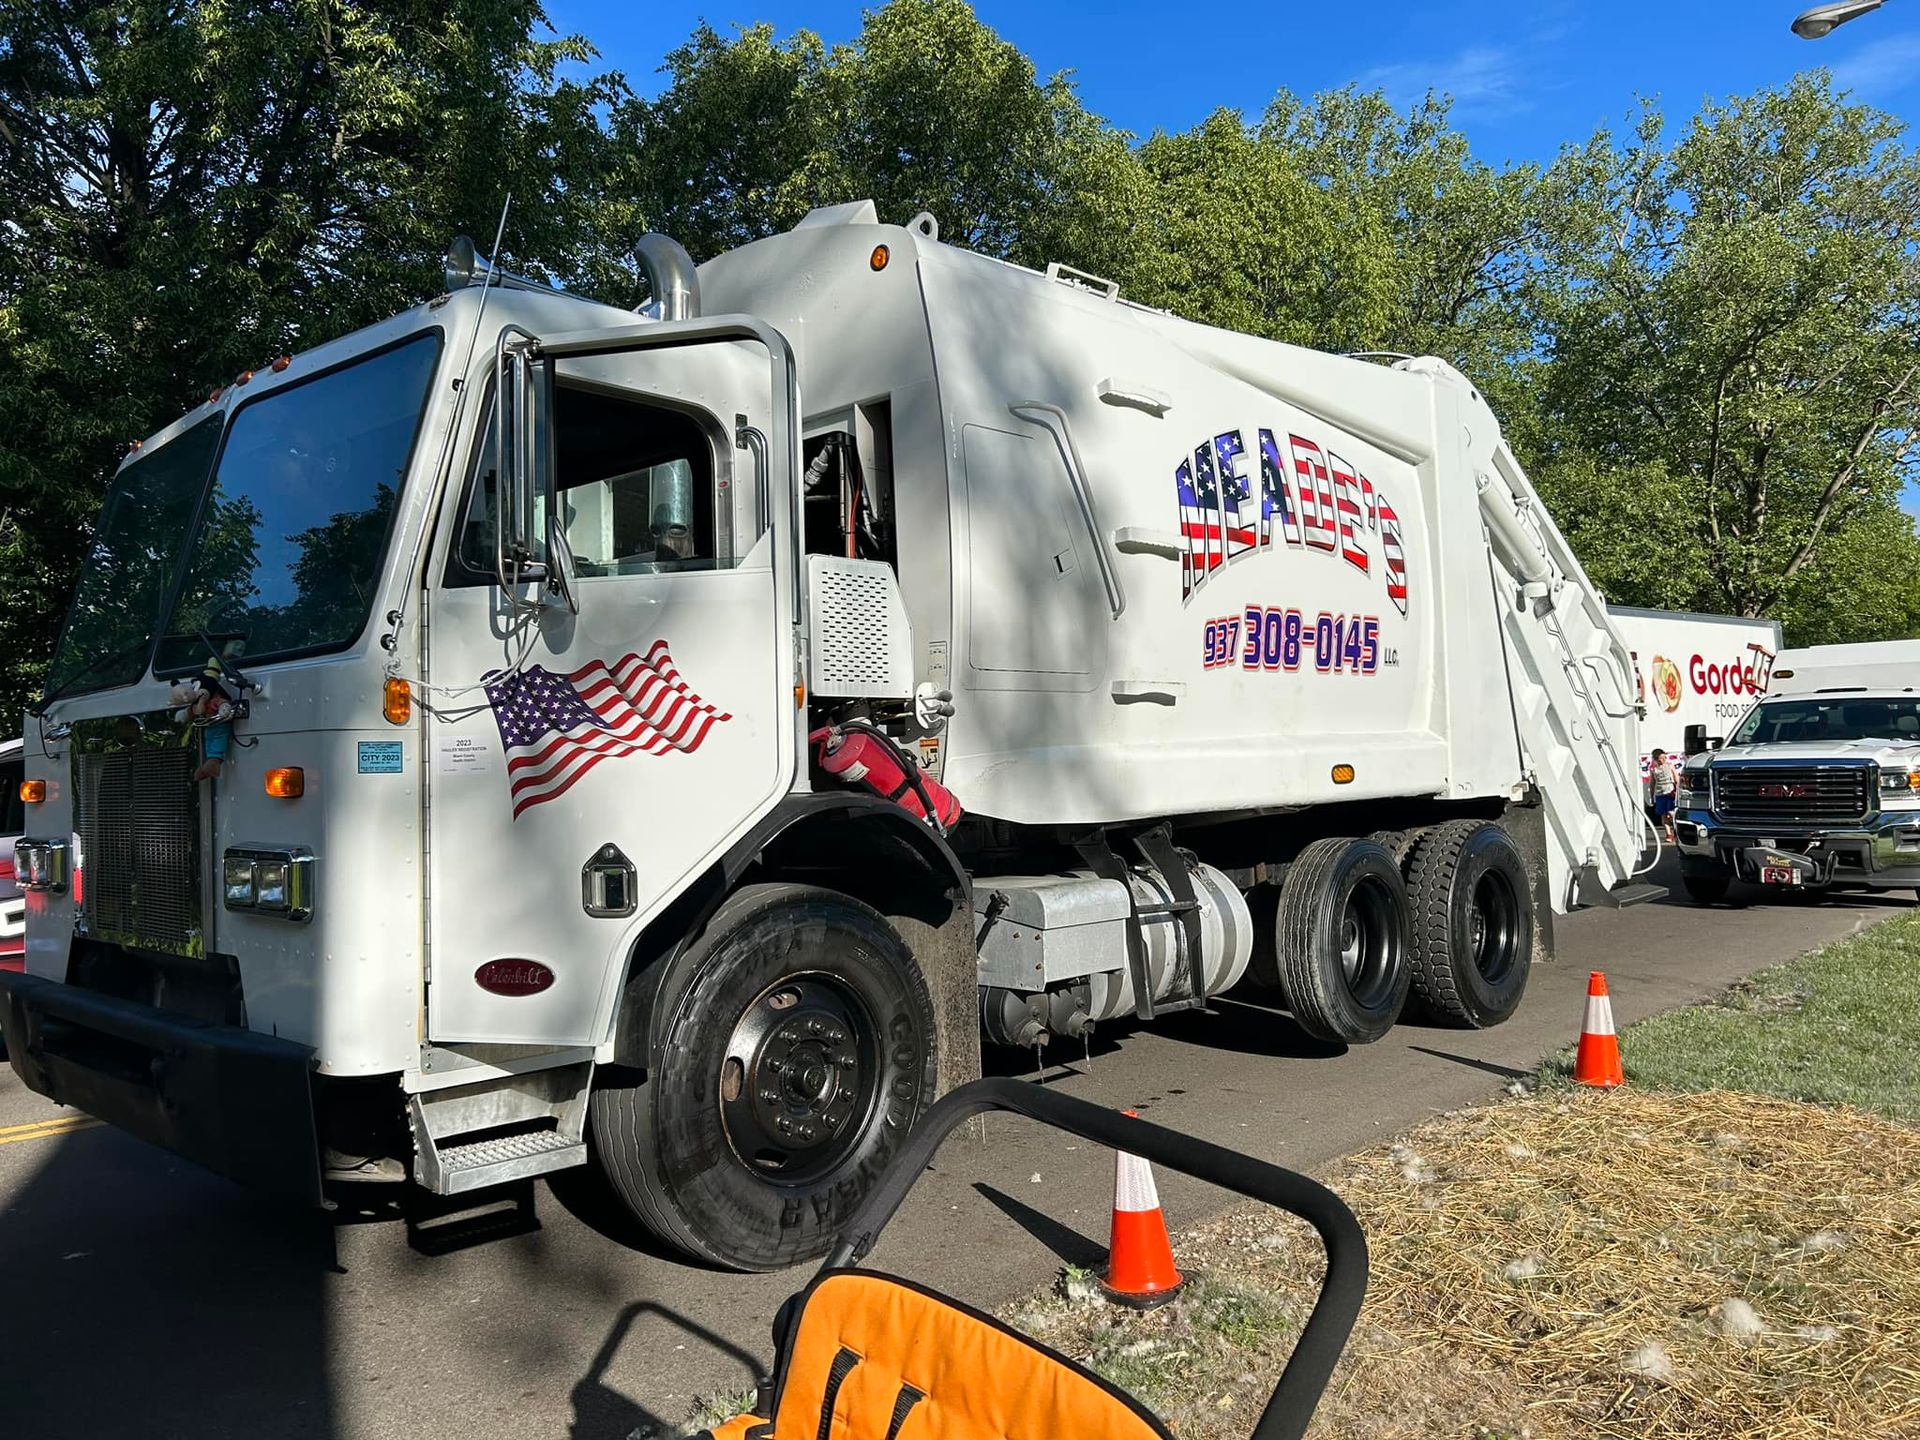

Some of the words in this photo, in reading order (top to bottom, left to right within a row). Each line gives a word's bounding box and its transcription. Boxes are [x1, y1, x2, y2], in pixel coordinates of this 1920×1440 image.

[1175, 427, 1408, 617] MEADE'S
[1203, 613, 1241, 671] 937
[1243, 604, 1379, 675] 308-0145
[1715, 704, 1739, 718] FOOD
[456, 739, 472, 747] 2023
[361, 754, 380, 762] CITY
[381, 754, 400, 762] 2023
